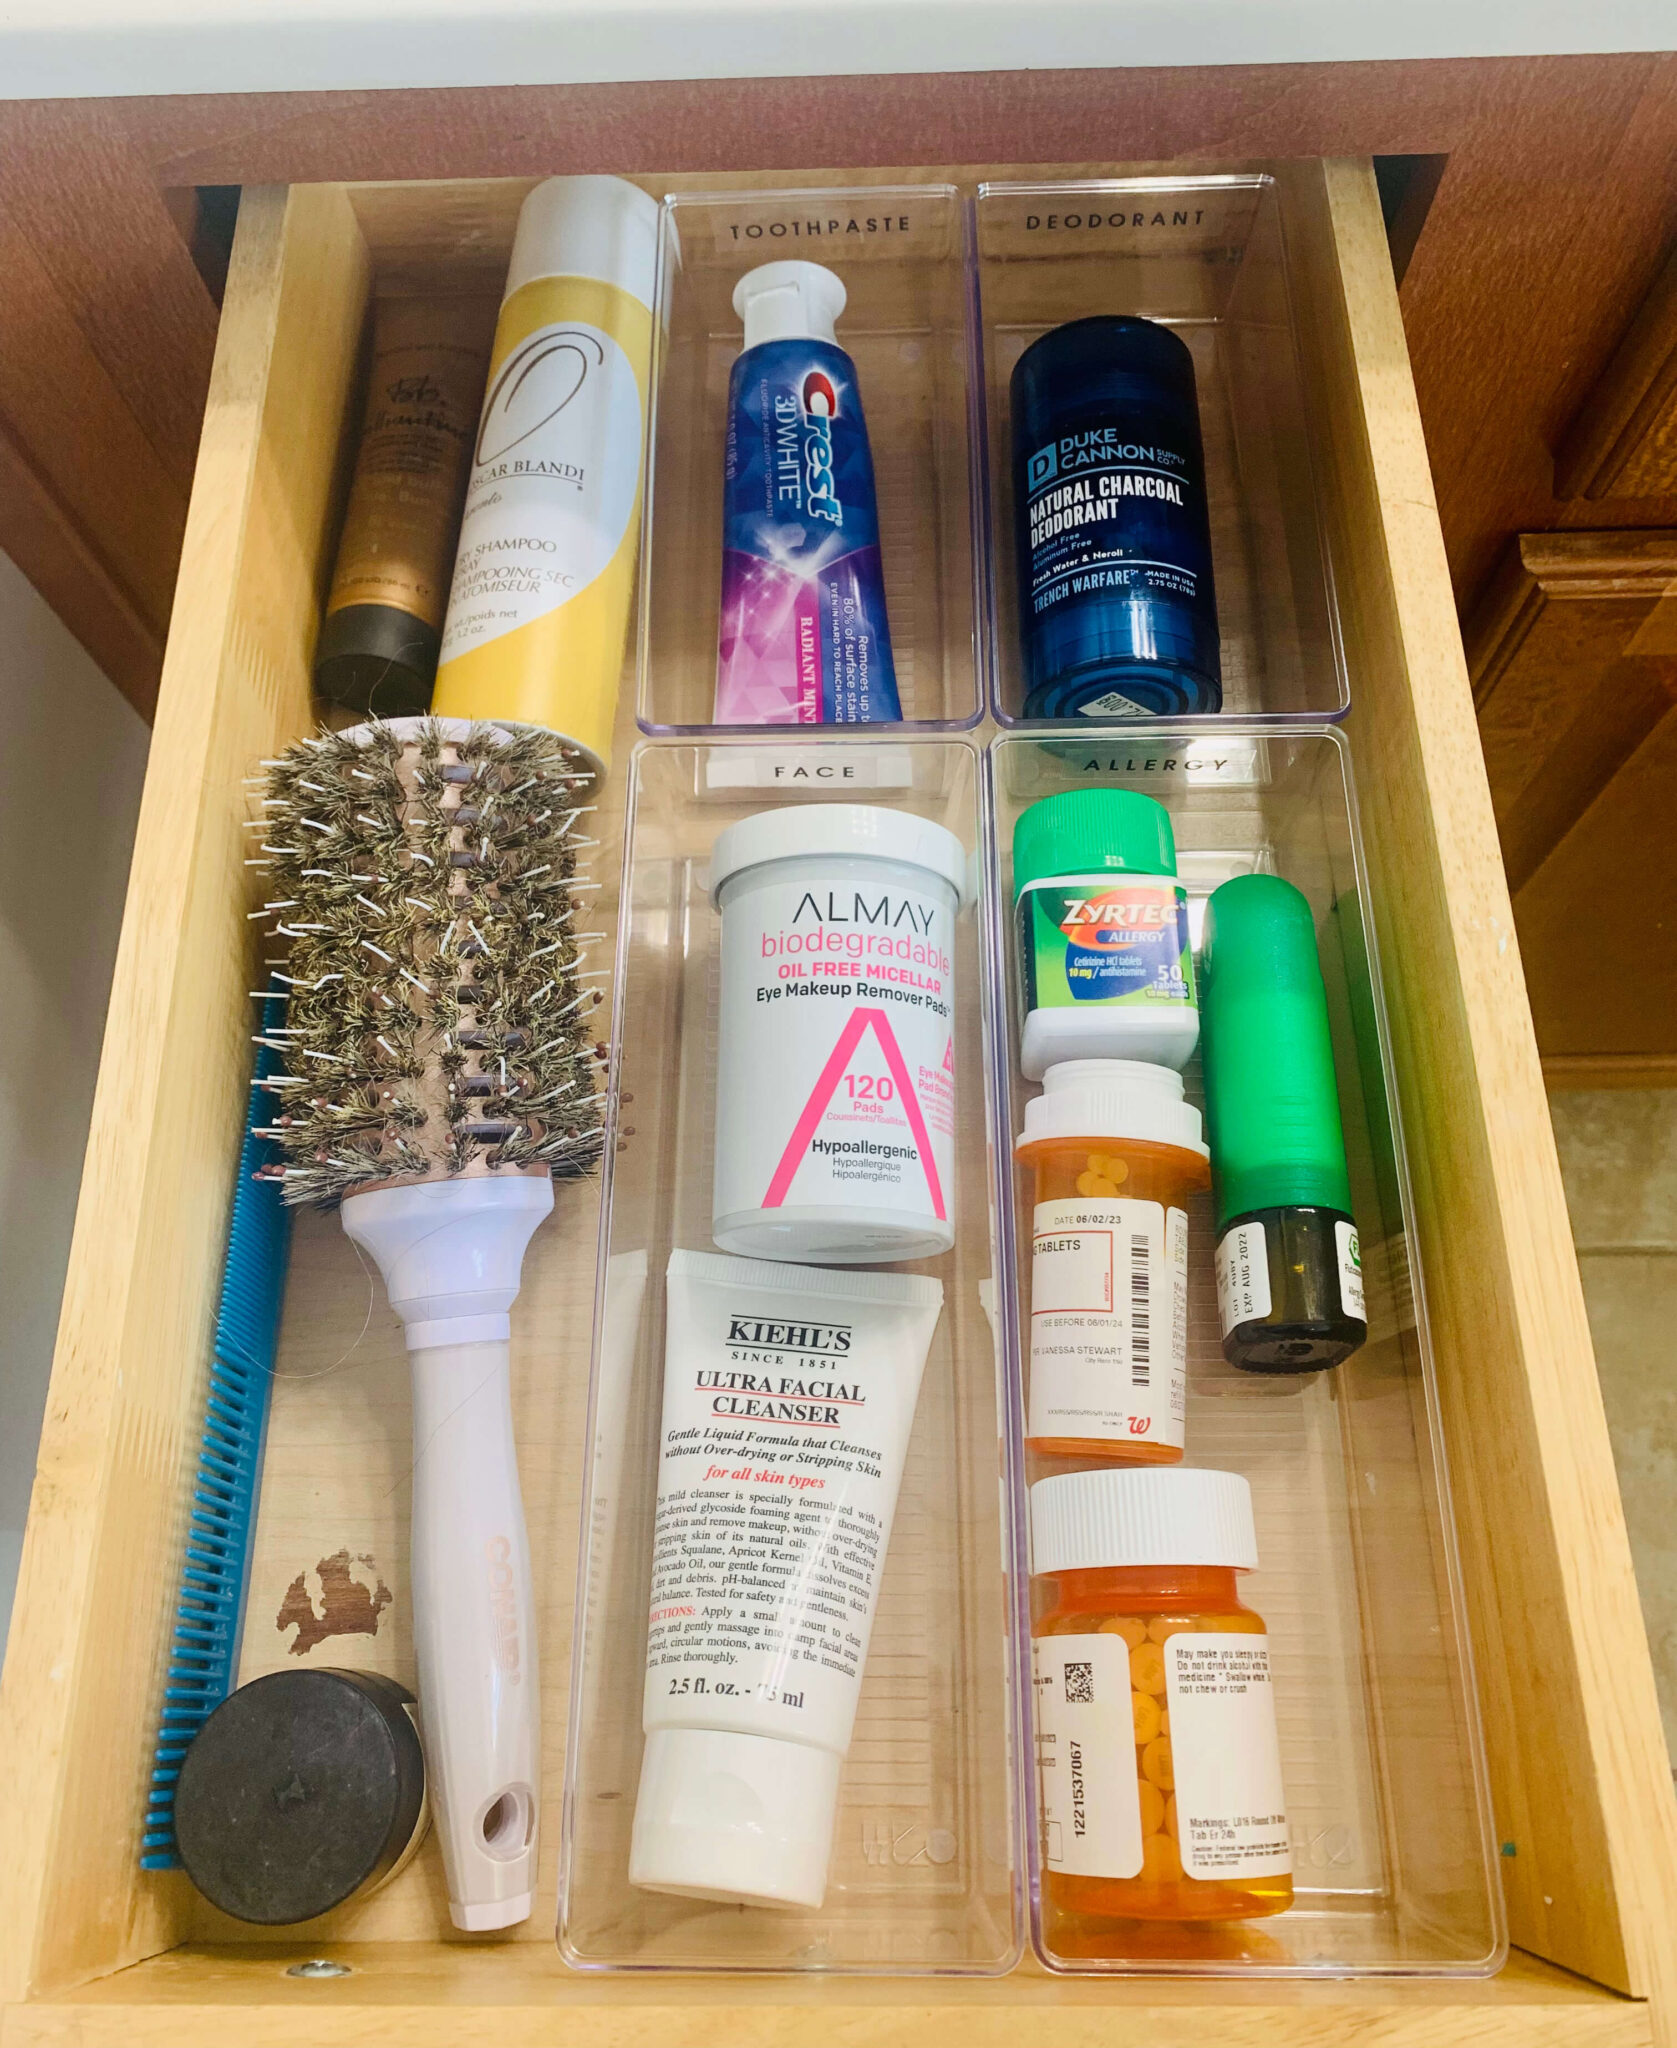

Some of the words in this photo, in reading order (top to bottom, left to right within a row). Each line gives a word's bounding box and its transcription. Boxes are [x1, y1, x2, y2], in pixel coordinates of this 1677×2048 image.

[729, 216, 910, 241] TOOTHPASTE
[1026, 209, 1205, 231] DEODORANT
[803, 371, 842, 523] Crest
[1060, 428, 1117, 454] DUKE
[1061, 444, 1154, 470] CANNON
[1157, 449, 1186, 466] SUPPLY
[513, 460, 584, 481] BLANDI
[1030, 480, 1094, 527] NATURAL
[1099, 475, 1184, 506] CHARCOAL
[1031, 498, 1119, 549] DEODORANT
[475, 538, 557, 556] SHAMPOO
[1032, 540, 1058, 560] Alcohol
[1060, 533, 1080, 544] Free
[1071, 540, 1092, 550] Free
[544, 570, 575, 588] SEC
[1033, 570, 1051, 587] Fresh
[1053, 558, 1079, 573] Water
[1082, 554, 1089, 562] &
[1093, 549, 1123, 560] Neroli
[1146, 570, 1170, 580] MADE
[1171, 574, 1180, 582] IN
[830, 582, 838, 607] EVEN
[1167, 581, 1178, 590] OZ
[1034, 581, 1069, 614] TRENCH
[499, 610, 517, 618] net
[843, 597, 854, 625] 80%
[832, 619, 840, 644] HARD
[844, 627, 855, 641] of
[800, 616, 815, 684] RADIANT
[833, 647, 840, 659] TO
[845, 643, 857, 689] surface
[858, 635, 869, 692] Removes
[834, 661, 842, 692] REACH
[803, 689, 817, 723] MINT
[858, 696, 869, 712] up
[774, 766, 856, 779] FACE
[1083, 758, 1229, 772] ALLERGY
[792, 891, 935, 936] ALMAY
[1062, 899, 1179, 928] ZYRTEC
[1108, 930, 1166, 943] ALLERGY
[761, 925, 950, 977] biodegradable
[778, 963, 807, 979] OIL
[812, 962, 861, 977] FREE
[866, 963, 941, 996] MICELLAR
[1069, 968, 1078, 977] 10
[1157, 964, 1183, 981] 50
[1152, 980, 1188, 990] Tablets
[756, 986, 782, 1003] Eye
[785, 981, 852, 998] Makeup
[856, 982, 924, 1006] Remover
[925, 995, 949, 1018] Pads
[843, 1074, 894, 1102] 120
[853, 1101, 884, 1114] Pads
[812, 1138, 918, 1160] Hypoallergenic
[832, 1157, 902, 1172] Hypoallergique
[832, 1169, 902, 1184] Hipoalergénico
[1054, 1216, 1074, 1225] DATE
[1076, 1215, 1122, 1224] 06/02/23
[1038, 1240, 1081, 1254] TABLETS
[1237, 1231, 1248, 1260] 2022
[1242, 1265, 1252, 1287] AUG
[1054, 1318, 1085, 1327] BEFORE
[727, 1320, 852, 1351] KIEHL'S
[731, 1351, 785, 1366] SINCE
[799, 1358, 837, 1370] 1851
[1042, 1346, 1075, 1356] VANESSA
[1077, 1346, 1123, 1356] STEWART
[696, 1370, 773, 1394] ULTRA
[778, 1377, 866, 1402] FACIAL
[712, 1396, 840, 1424] CLEANSER
[668, 1427, 701, 1443] Gentle
[703, 1427, 744, 1442] Liquid
[745, 1430, 800, 1448] Formula
[802, 1437, 826, 1450] that
[830, 1438, 883, 1462] Cleanses
[665, 1444, 702, 1459] without
[703, 1443, 776, 1464] Over-drying
[780, 1452, 794, 1462] or
[795, 1452, 853, 1472] Stripping
[855, 1461, 882, 1479] Skin
[703, 1464, 728, 1482] for
[731, 1467, 751, 1481] all
[754, 1469, 785, 1485] skin
[788, 1475, 826, 1490] types
[668, 1490, 687, 1502] mild
[690, 1489, 730, 1500] cleanser
[749, 1493, 793, 1507] specially
[858, 1511, 876, 1525] with
[672, 1518, 688, 1528] skin
[709, 1519, 746, 1528] remove
[748, 1520, 790, 1534] makeup,
[700, 1502, 746, 1515] glycoside
[750, 1505, 790, 1520] foaming
[794, 1512, 821, 1523] agent
[838, 1518, 880, 1544] thoroughly
[692, 1530, 710, 1540] skin
[749, 1534, 783, 1546] natural
[681, 1544, 725, 1556] Squalane,
[729, 1545, 766, 1558] Apricot
[832, 1559, 864, 1580] Vitamin
[728, 1561, 759, 1571] gentle
[686, 1572, 717, 1583] debris.
[722, 1573, 785, 1590] pH-balanced
[696, 1587, 726, 1598] Tested
[746, 1590, 776, 1605] safety
[701, 1606, 733, 1619] Apply
[670, 1636, 703, 1647] circular
[707, 1636, 750, 1651] motions,
[684, 1620, 713, 1634] gently
[717, 1623, 760, 1636] massage
[764, 1625, 784, 1638] into
[819, 1638, 842, 1655] facial
[661, 1653, 681, 1665] Rinse
[684, 1651, 738, 1665] thoroughly.
[1176, 1649, 1193, 1660] May
[1196, 1649, 1217, 1659] make
[1177, 1661, 1188, 1670] Do
[1192, 1661, 1205, 1670] not
[1207, 1661, 1227, 1670] drink
[669, 1678, 689, 1697] 2.5
[693, 1678, 710, 1694] fl.
[715, 1682, 740, 1696] oz.
[782, 1692, 804, 1708] ml
[1070, 1740, 1086, 1839] 1221537067
[1189, 1818, 1229, 1829] Markings:
[1190, 1830, 1207, 1840] Tab
